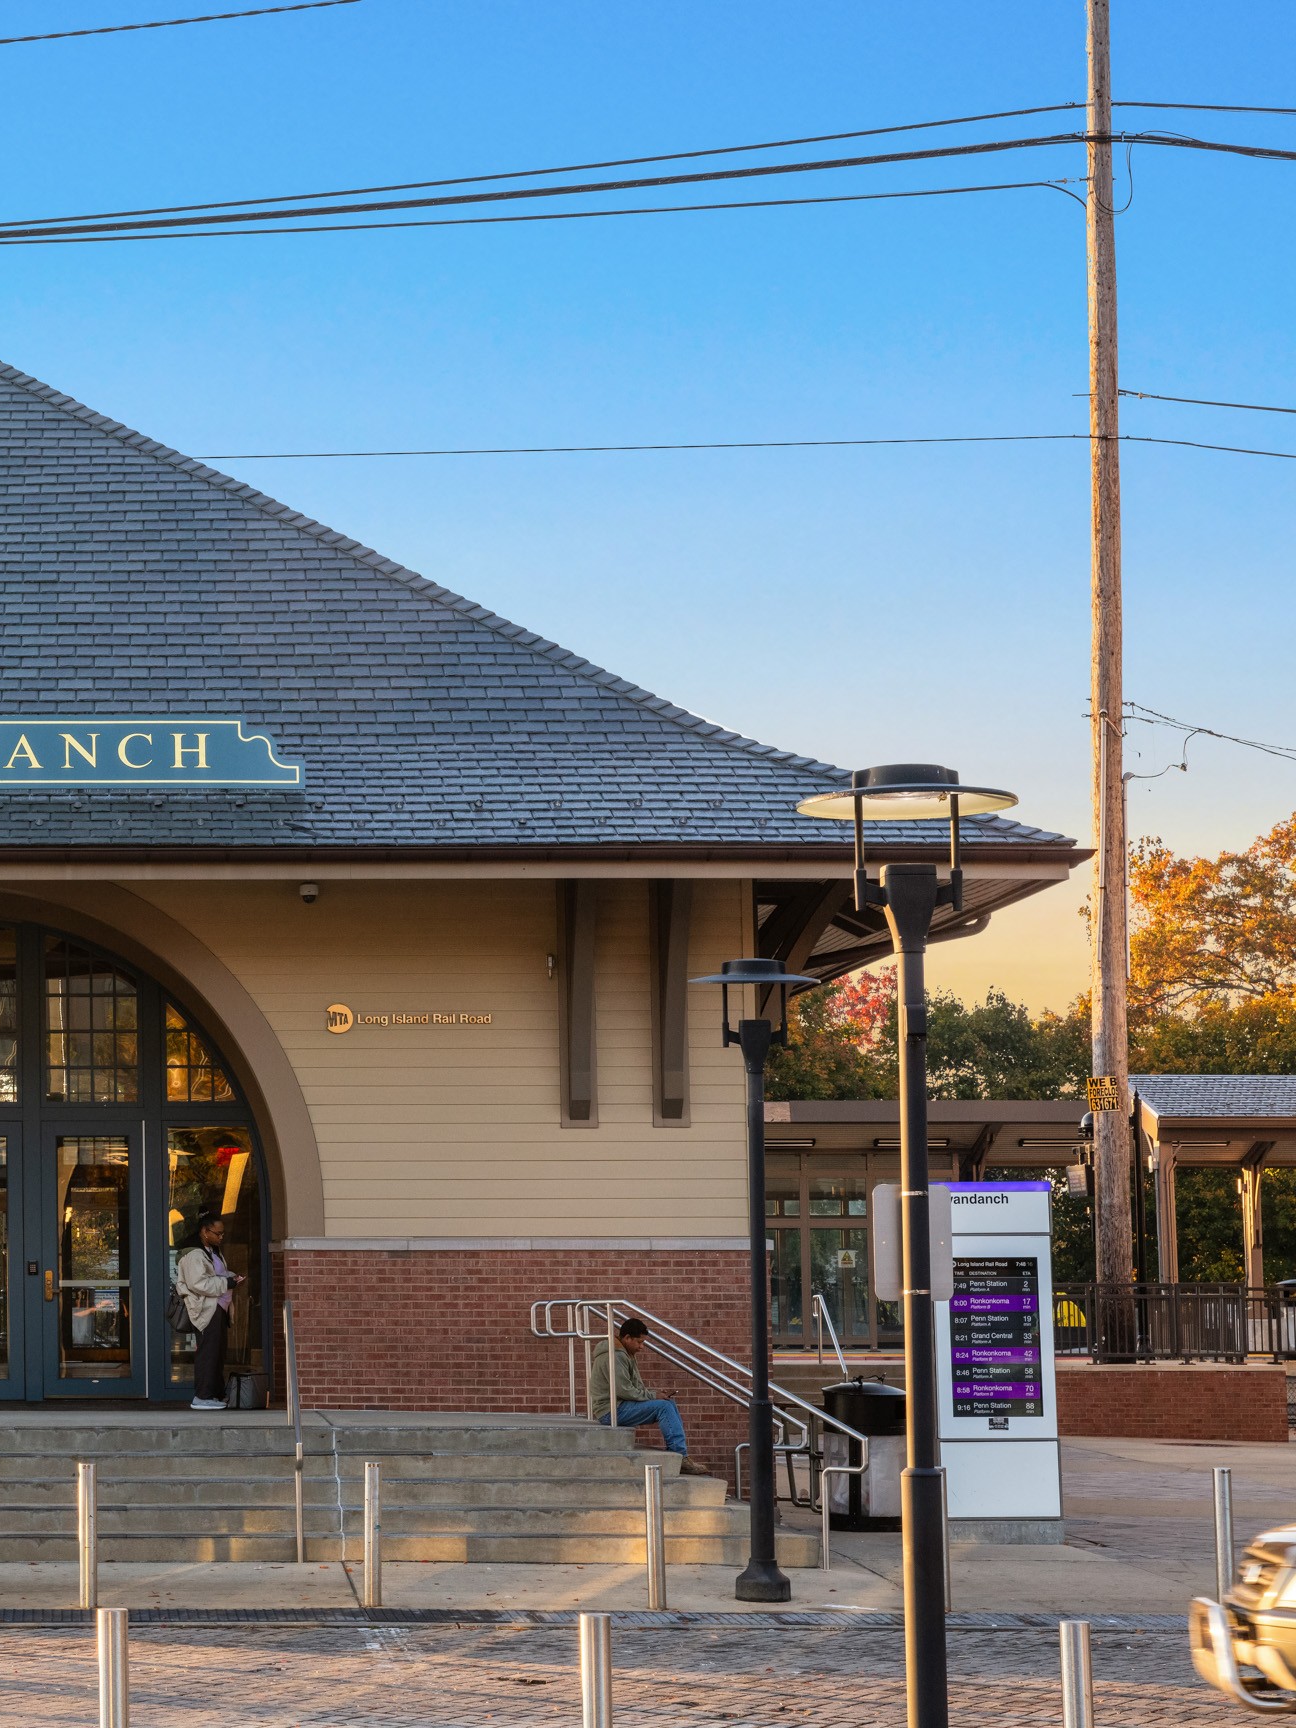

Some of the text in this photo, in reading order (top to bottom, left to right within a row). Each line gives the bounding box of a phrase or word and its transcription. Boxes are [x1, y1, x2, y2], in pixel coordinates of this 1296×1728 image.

[357, 1013, 389, 1027] Long
[392, 1013, 428, 1024] Island
[433, 1013, 456, 1024] Rail
[460, 1013, 492, 1024] Road
[1089, 1078, 1117, 1087] WE B
[1092, 1098, 1118, 1110] 631671
[951, 1193, 1009, 1204] andanch
